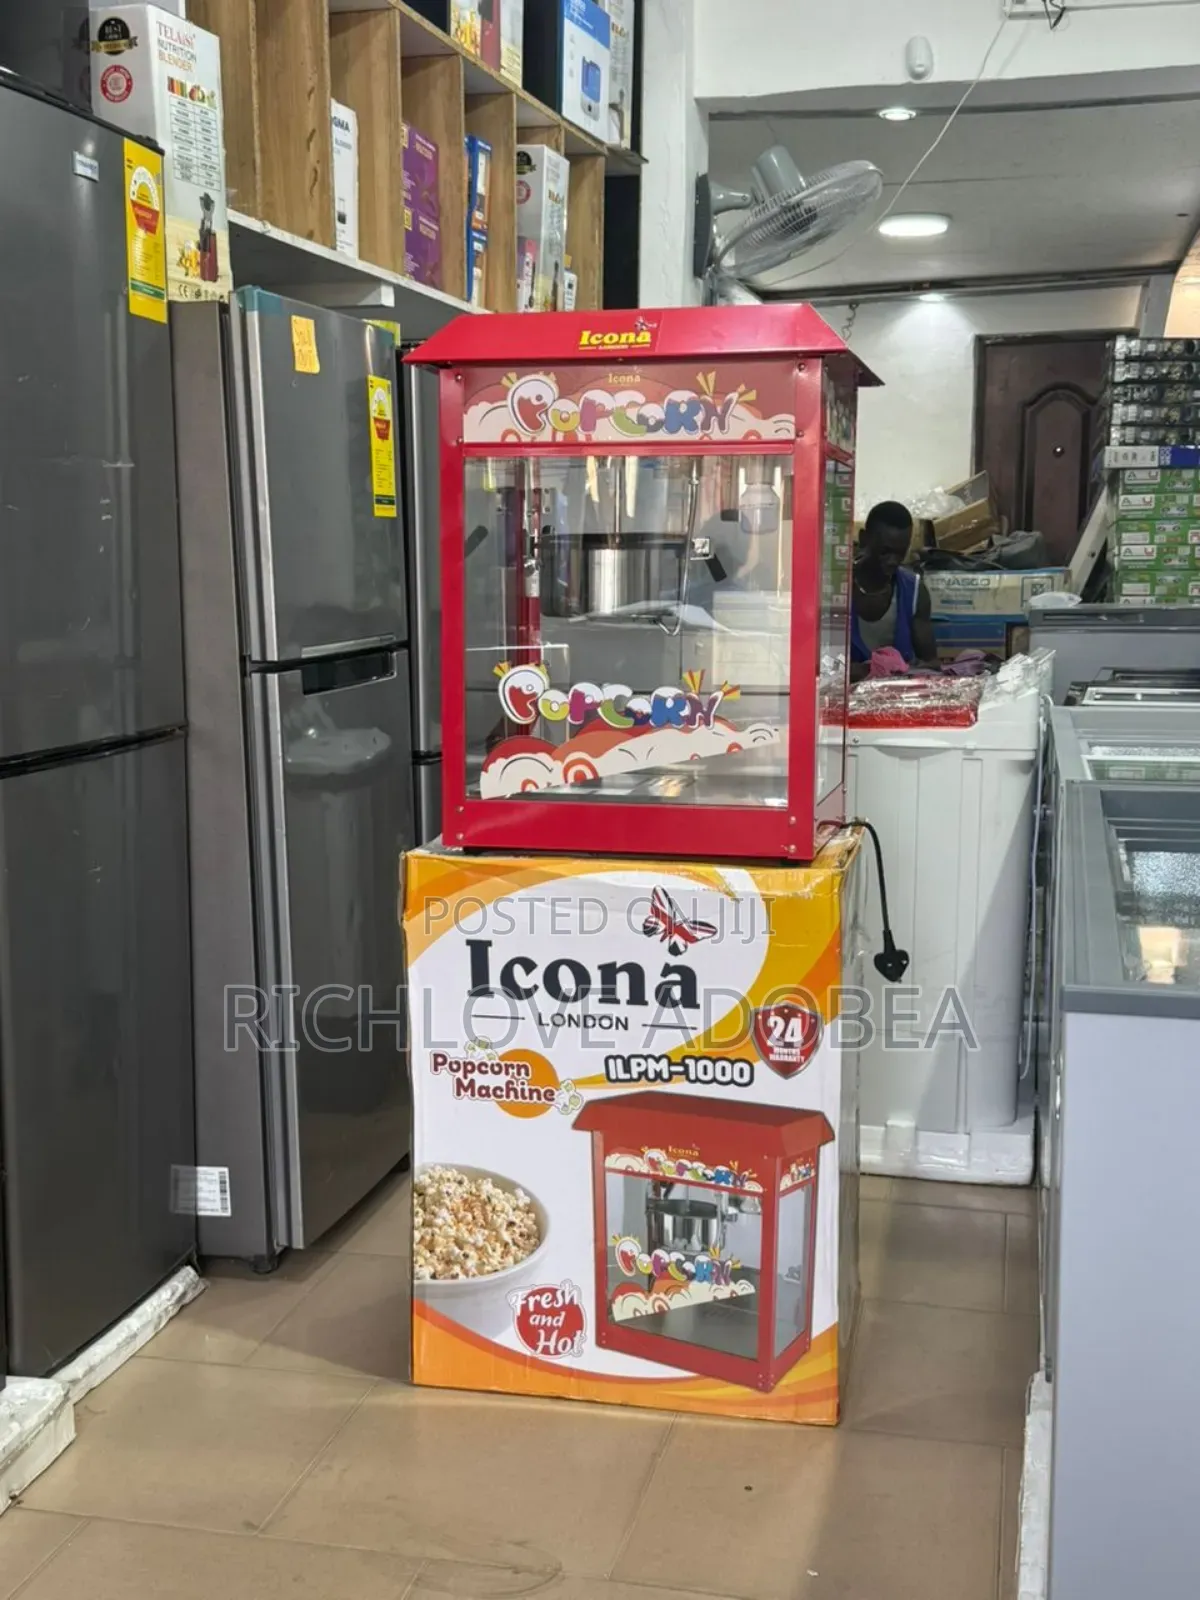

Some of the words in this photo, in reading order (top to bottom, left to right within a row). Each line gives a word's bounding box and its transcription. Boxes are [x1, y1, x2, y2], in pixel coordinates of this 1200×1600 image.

[579, 329, 652, 346] Icona
[608, 372, 641, 384] Icona
[465, 938, 701, 1010] Icona
[537, 1012, 629, 1031] LONDON
[767, 1015, 805, 1047] 24
[431, 1052, 531, 1079] Popcorn
[604, 1054, 755, 1087] ILPM-1000
[454, 1076, 557, 1102] Machine
[668, 1145, 700, 1157] Icona
[509, 1283, 579, 1317] Fresh
[529, 1311, 566, 1329] and
[535, 1329, 587, 1355] Hot
